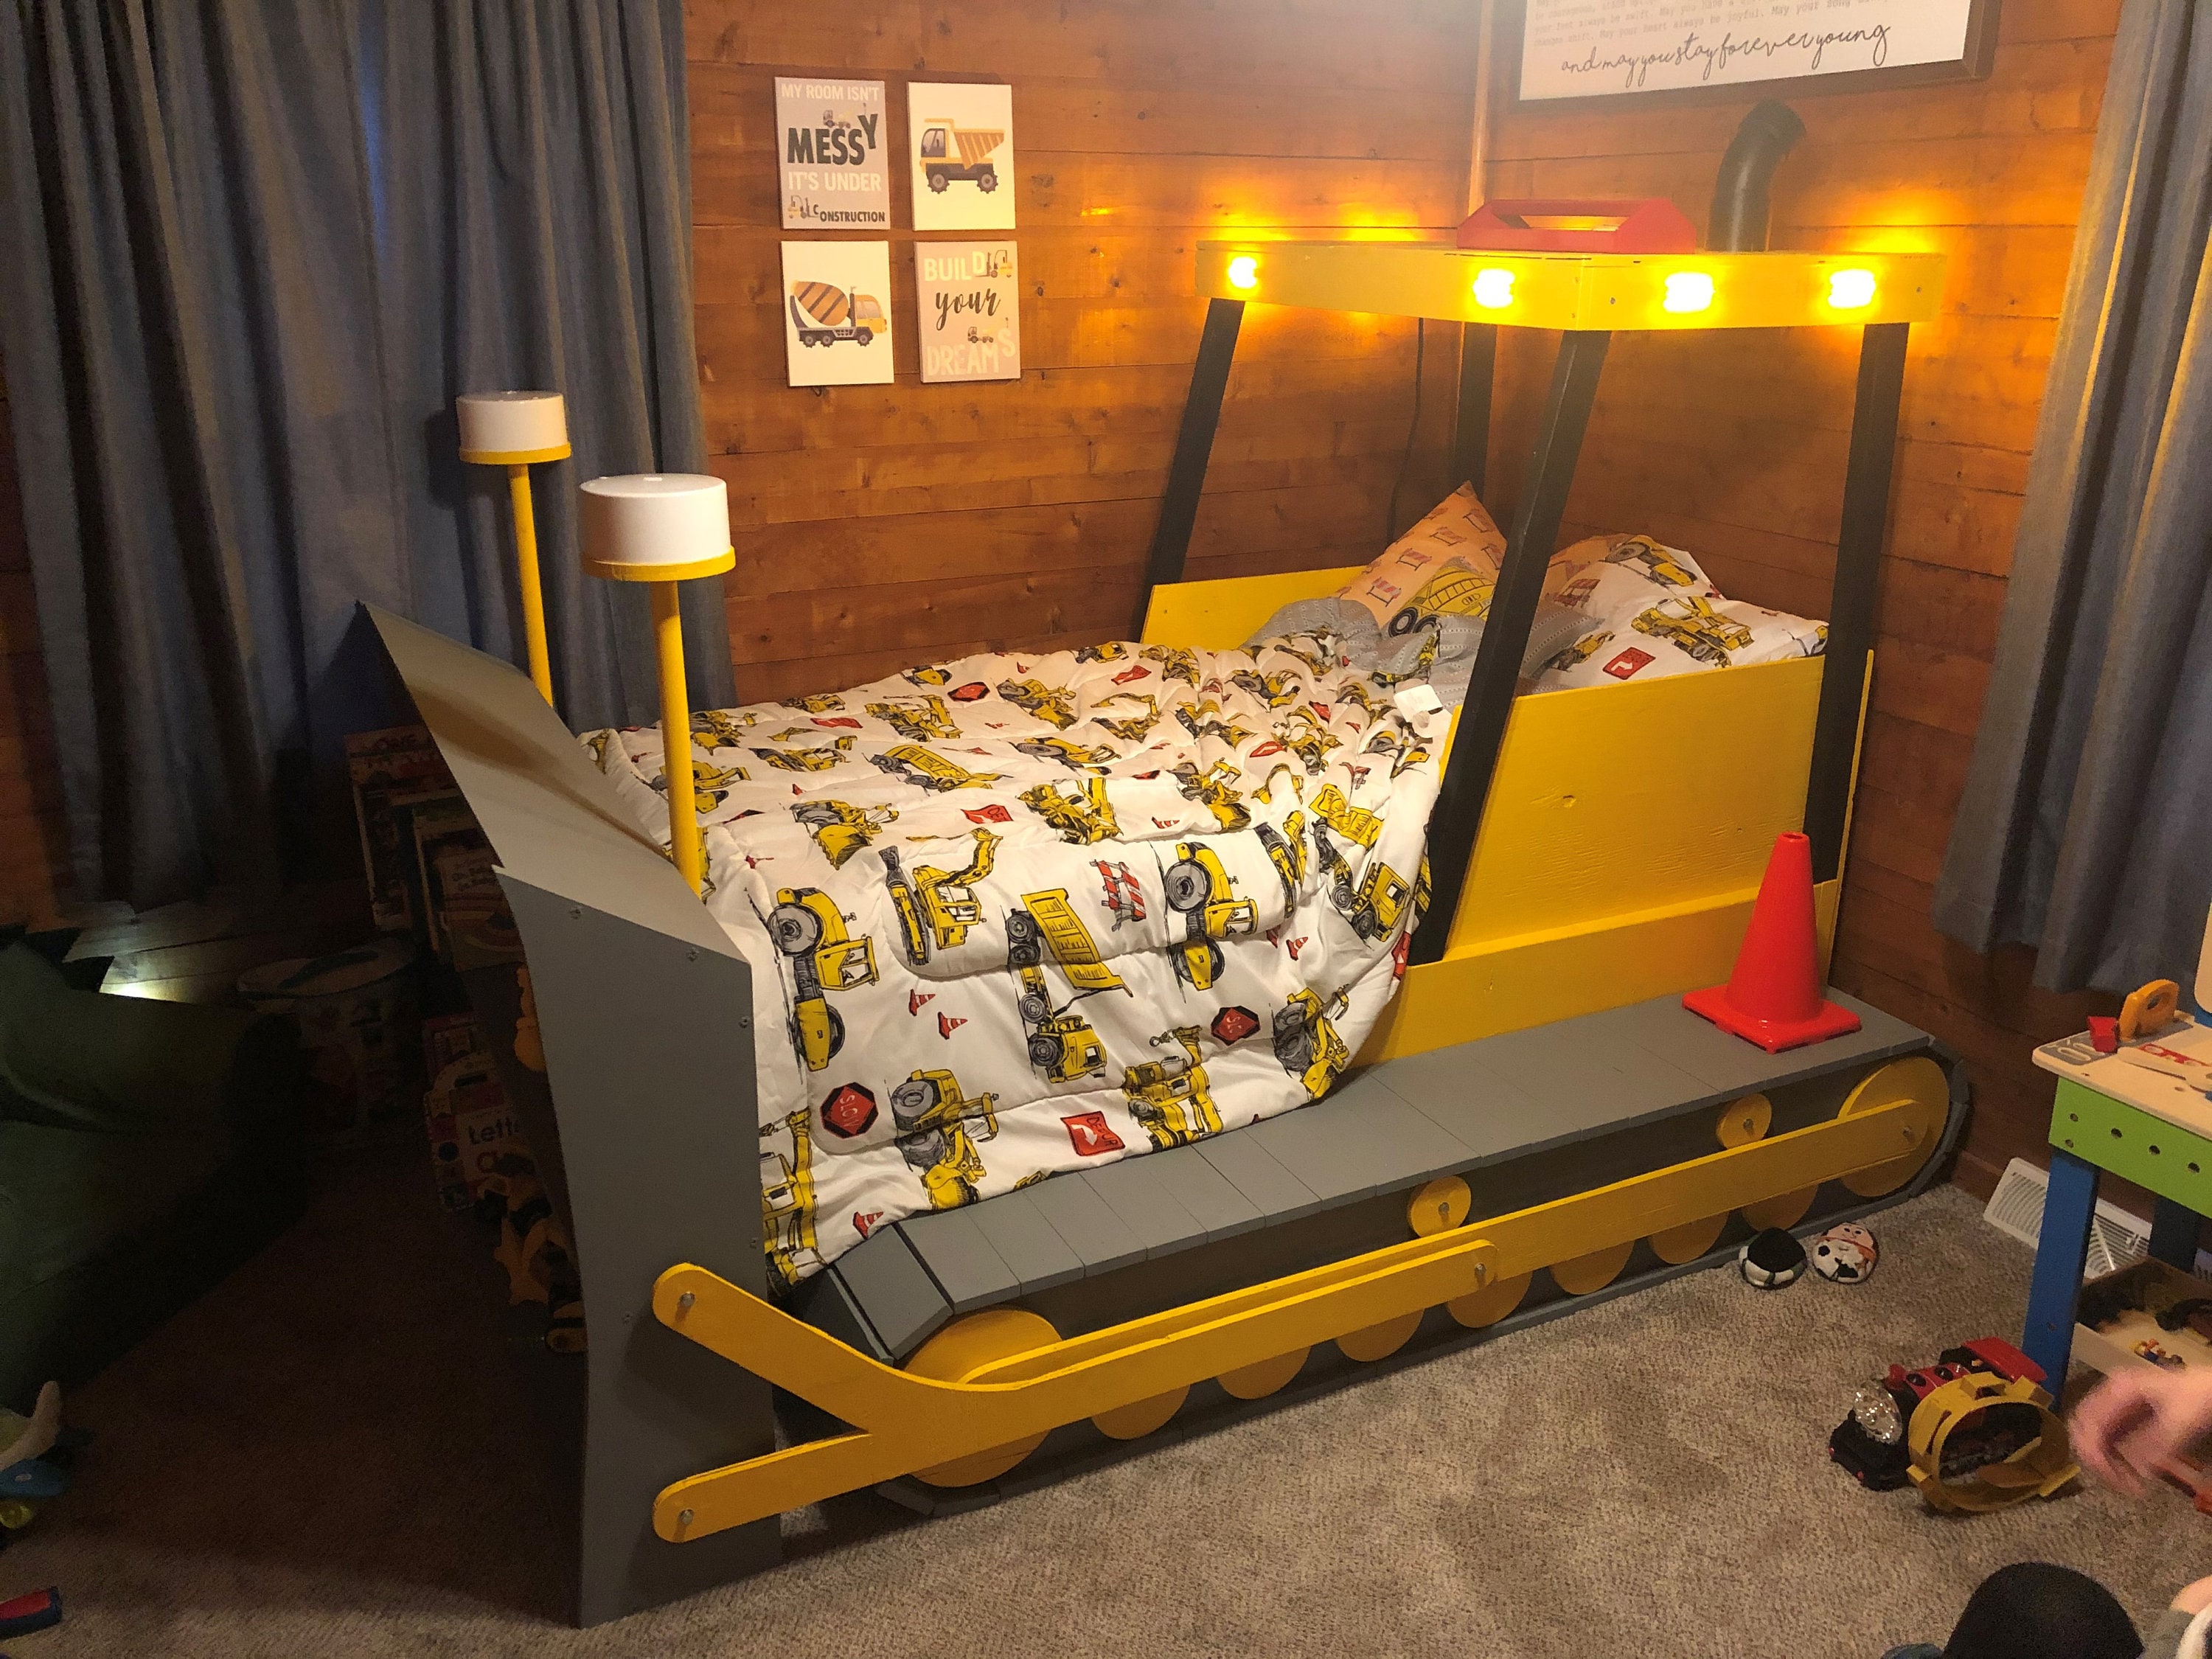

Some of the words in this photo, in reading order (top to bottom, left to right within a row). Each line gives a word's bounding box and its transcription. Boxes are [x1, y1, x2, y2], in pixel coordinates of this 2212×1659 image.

[781, 83, 801, 97] MY
[806, 85, 843, 100] ROOM
[847, 86, 880, 102] ISN'T
[787, 113, 878, 166] MESSY
[788, 172, 818, 191] IT'S
[824, 173, 881, 192] UNDER
[813, 204, 885, 223] CONSTRUCTION
[924, 251, 987, 282] BUILD
[936, 288, 1001, 330] your
[927, 327, 1016, 377] DREAMS
